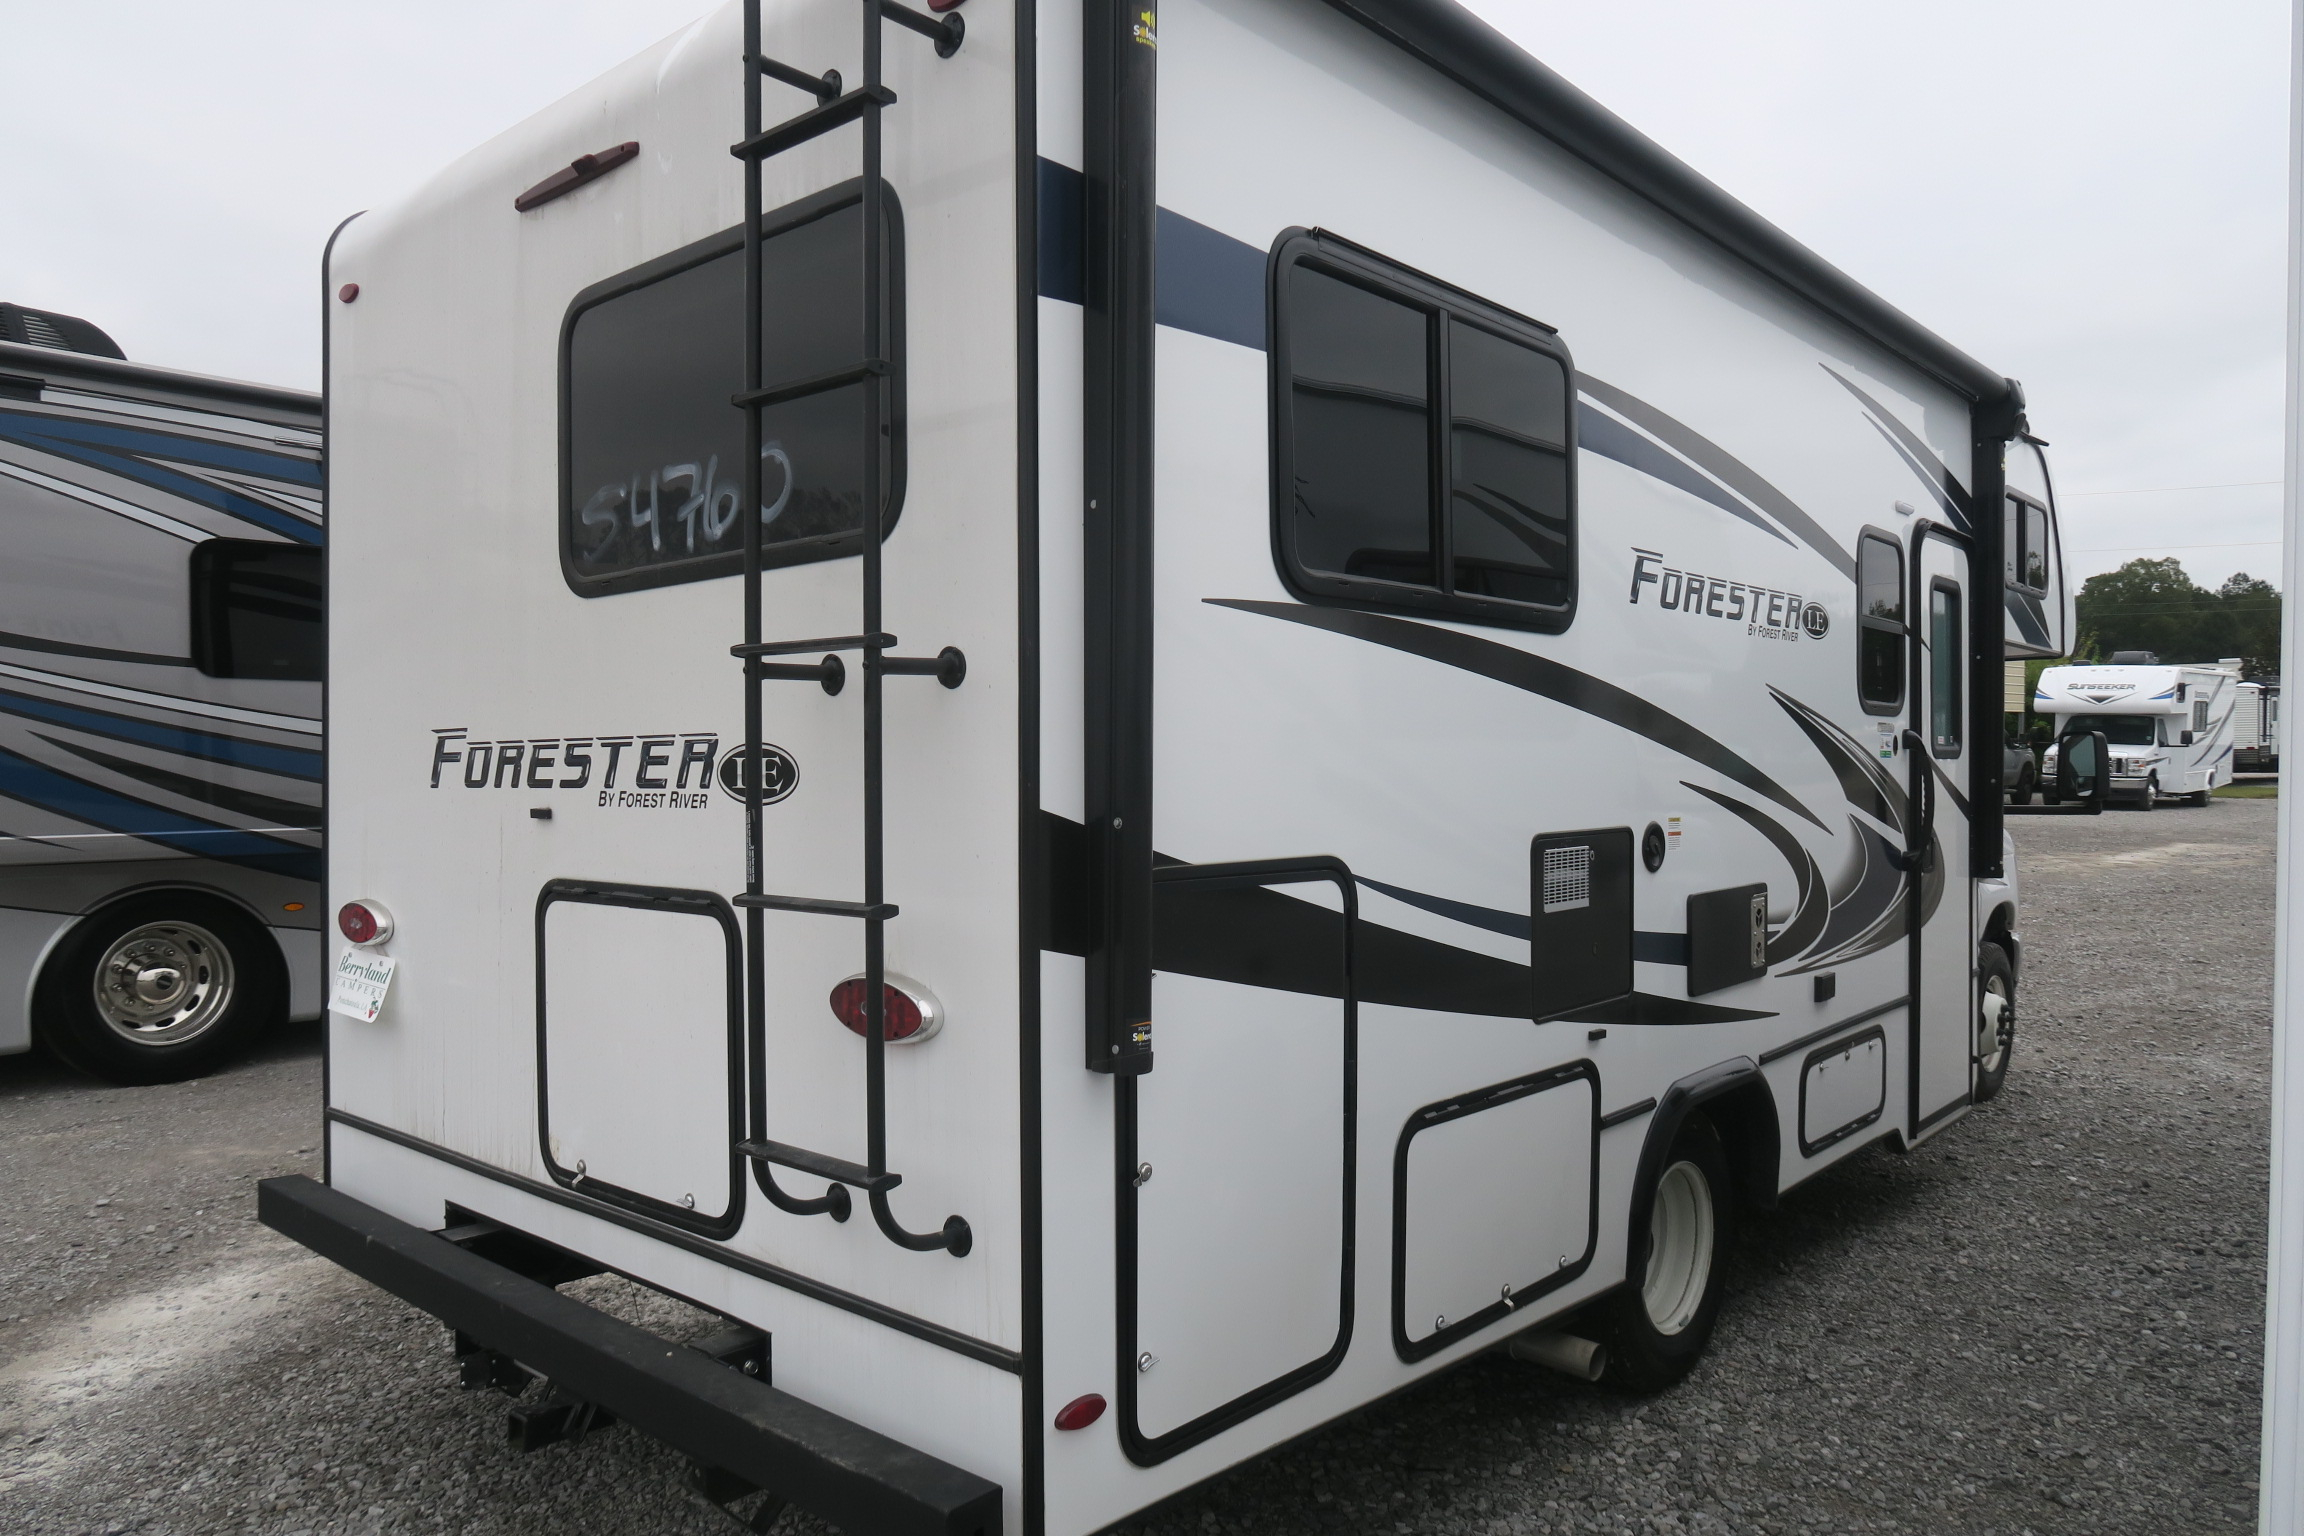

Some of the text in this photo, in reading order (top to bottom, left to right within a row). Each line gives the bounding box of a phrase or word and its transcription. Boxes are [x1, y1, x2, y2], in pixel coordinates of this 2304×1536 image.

[1629, 546, 1803, 630] FORESTER
[1758, 625, 1781, 640] FOREST
[1781, 629, 1799, 642] RIVER
[430, 727, 720, 789] FORESTER
[598, 790, 709, 809] BY FOREST RIVER
[339, 955, 391, 984] Berryland
